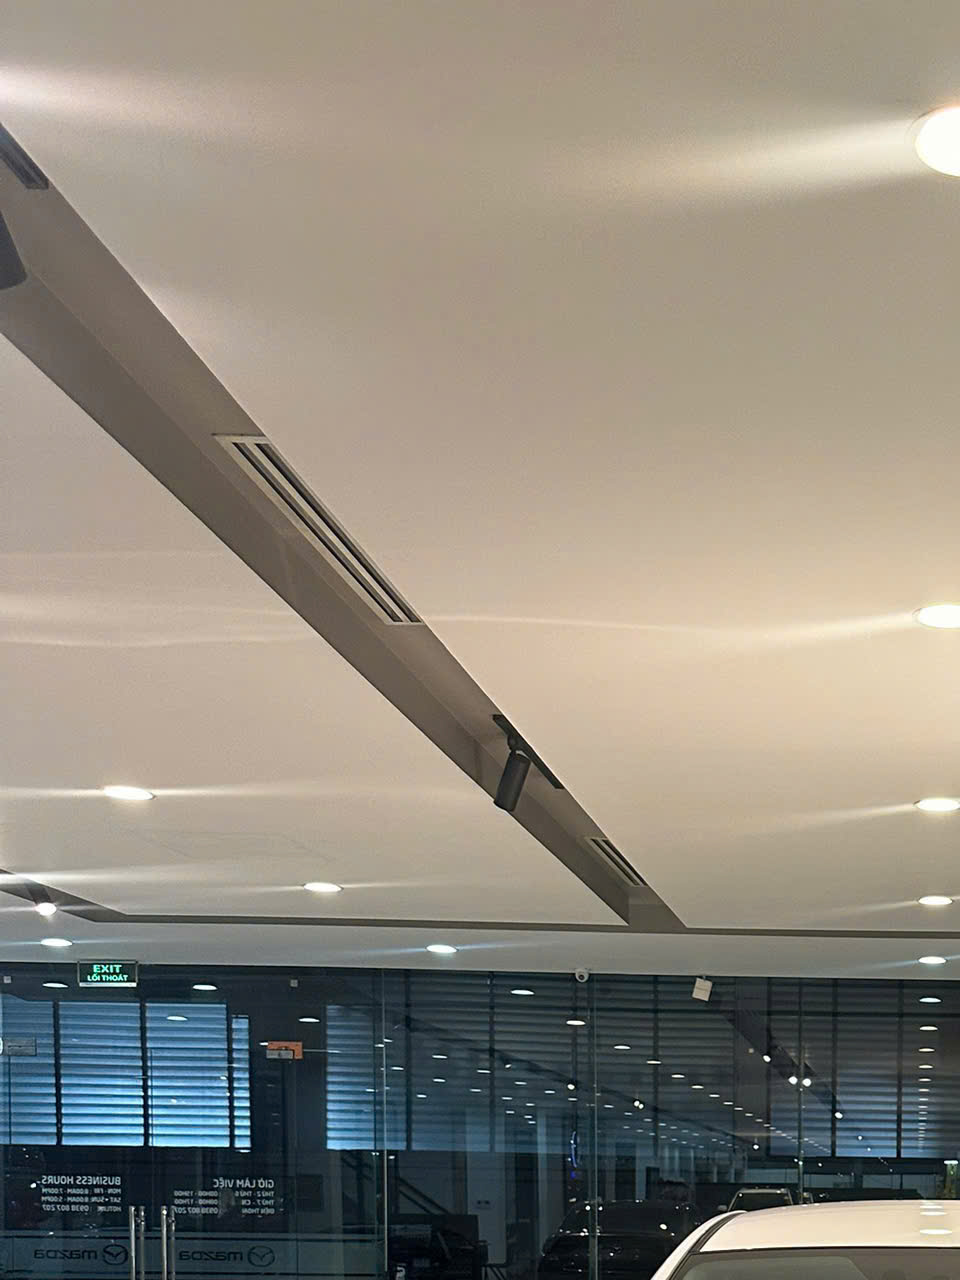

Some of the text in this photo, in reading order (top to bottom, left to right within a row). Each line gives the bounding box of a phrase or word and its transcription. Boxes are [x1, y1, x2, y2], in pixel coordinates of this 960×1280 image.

[93, 964, 122, 973] EXIT
[87, 973, 128, 981] LỐI THOÁT
